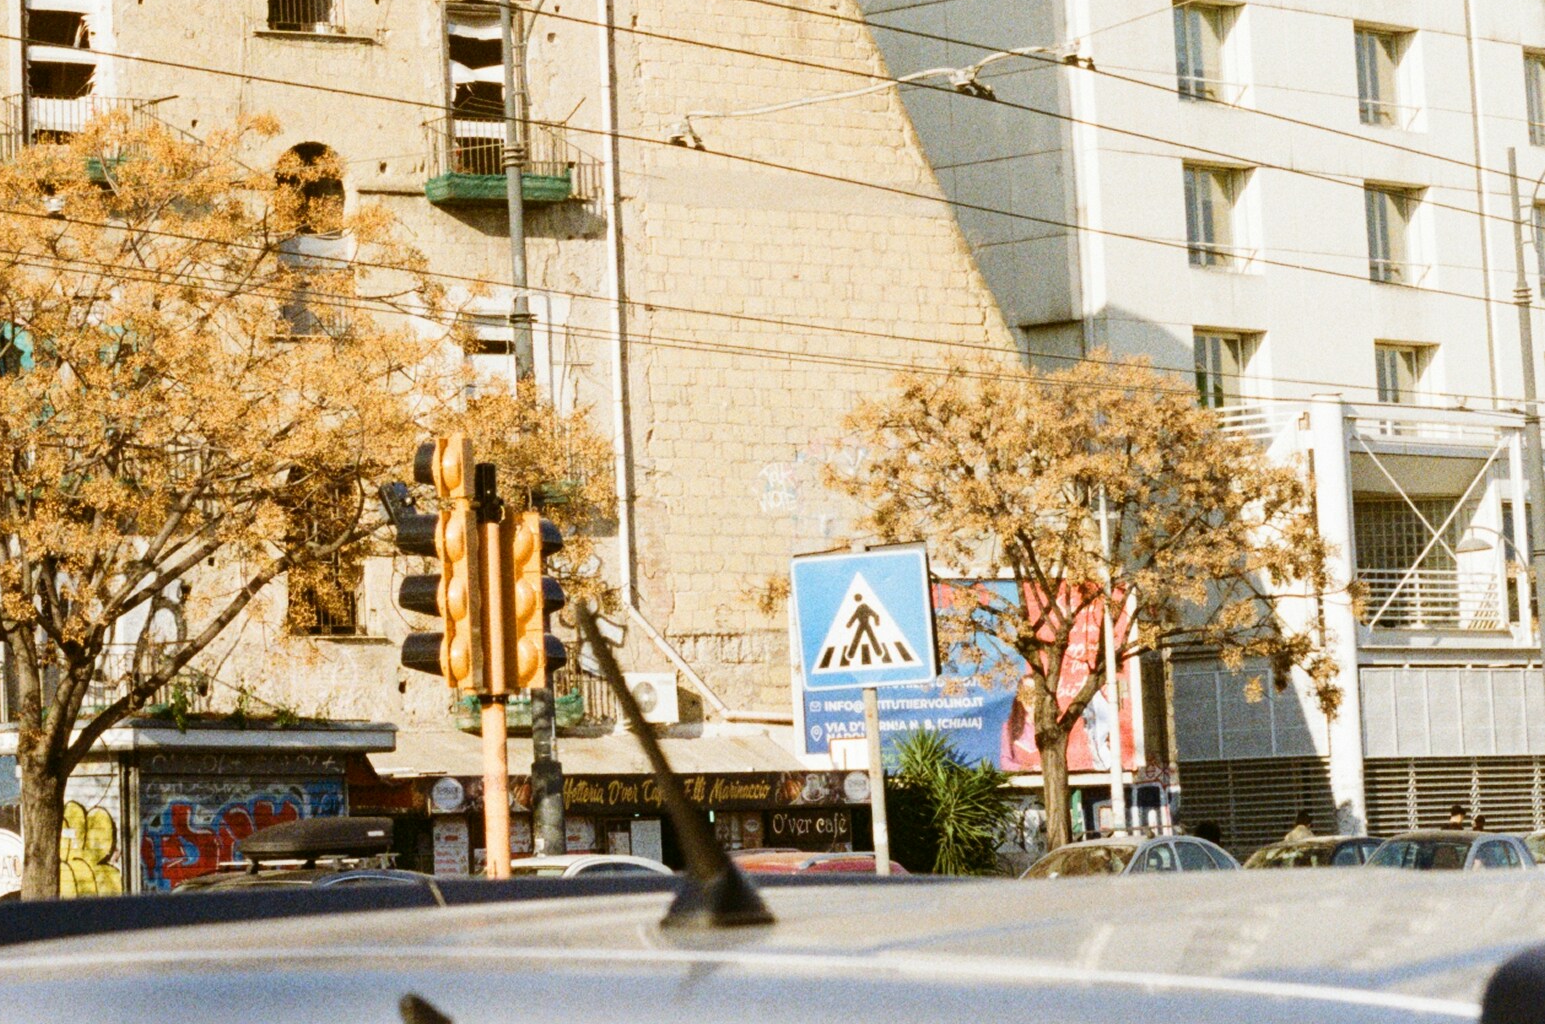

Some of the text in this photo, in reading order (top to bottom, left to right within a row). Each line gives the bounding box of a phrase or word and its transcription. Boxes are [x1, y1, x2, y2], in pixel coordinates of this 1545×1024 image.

[825, 721, 847, 734] VIA
[849, 719, 908, 733] D'IRNIA
[772, 812, 848, 838] O'ver cafè
